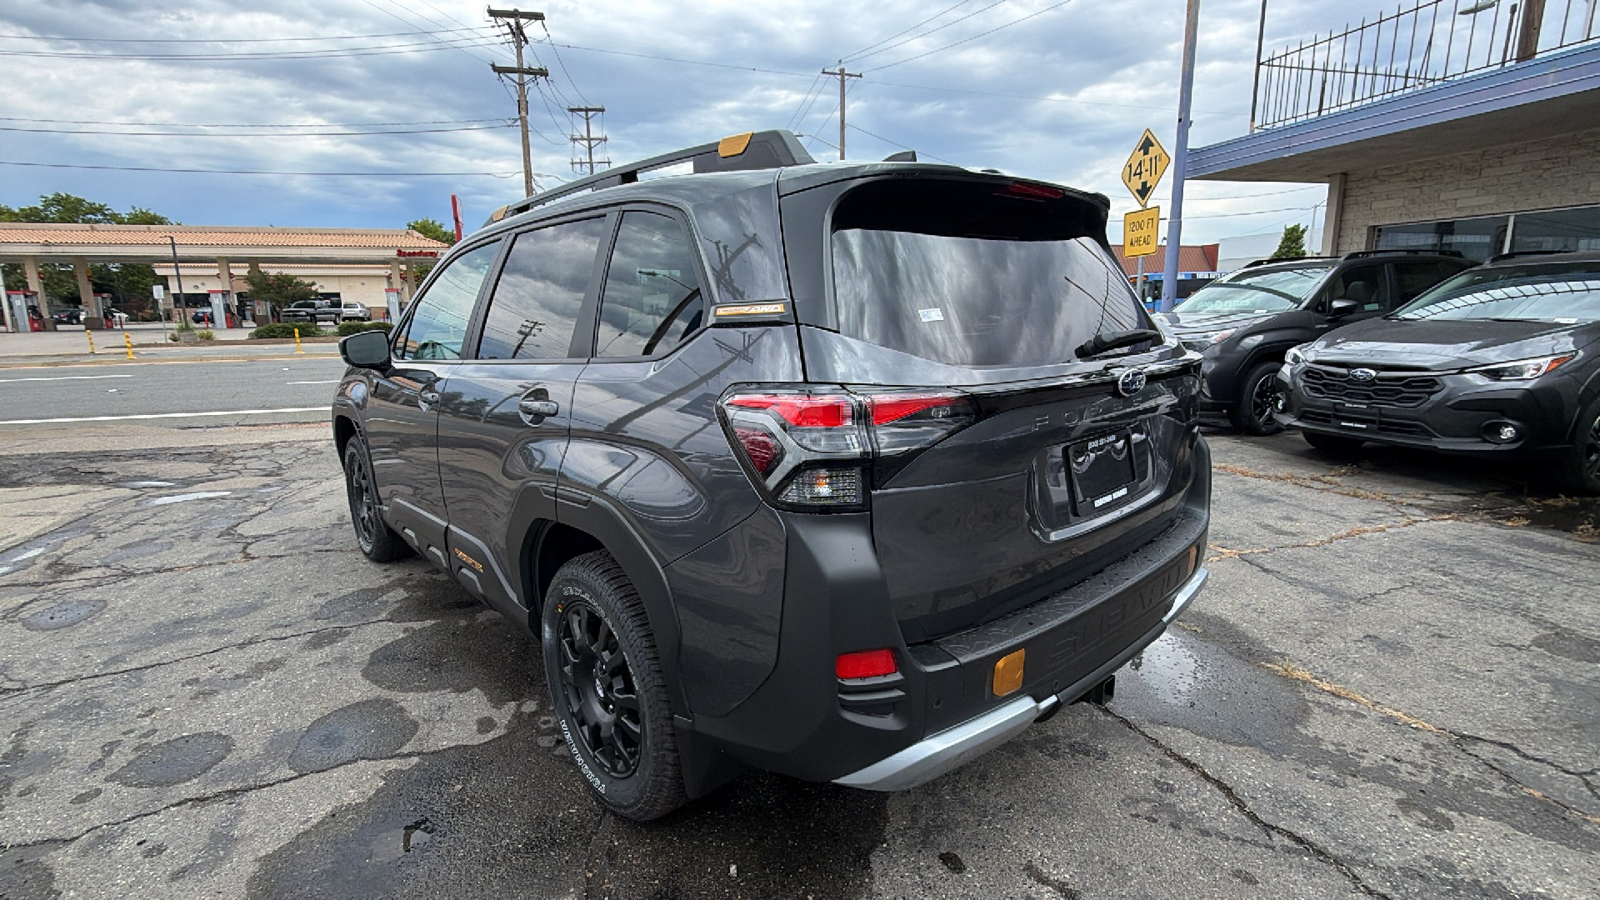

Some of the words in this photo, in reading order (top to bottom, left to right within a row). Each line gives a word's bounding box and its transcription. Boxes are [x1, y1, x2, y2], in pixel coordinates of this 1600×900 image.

[1129, 220, 1145, 232] 1200
[1147, 218, 1154, 229] FT
[1130, 235, 1151, 247] AHEAD
[397, 249, 437, 258] Speedway
